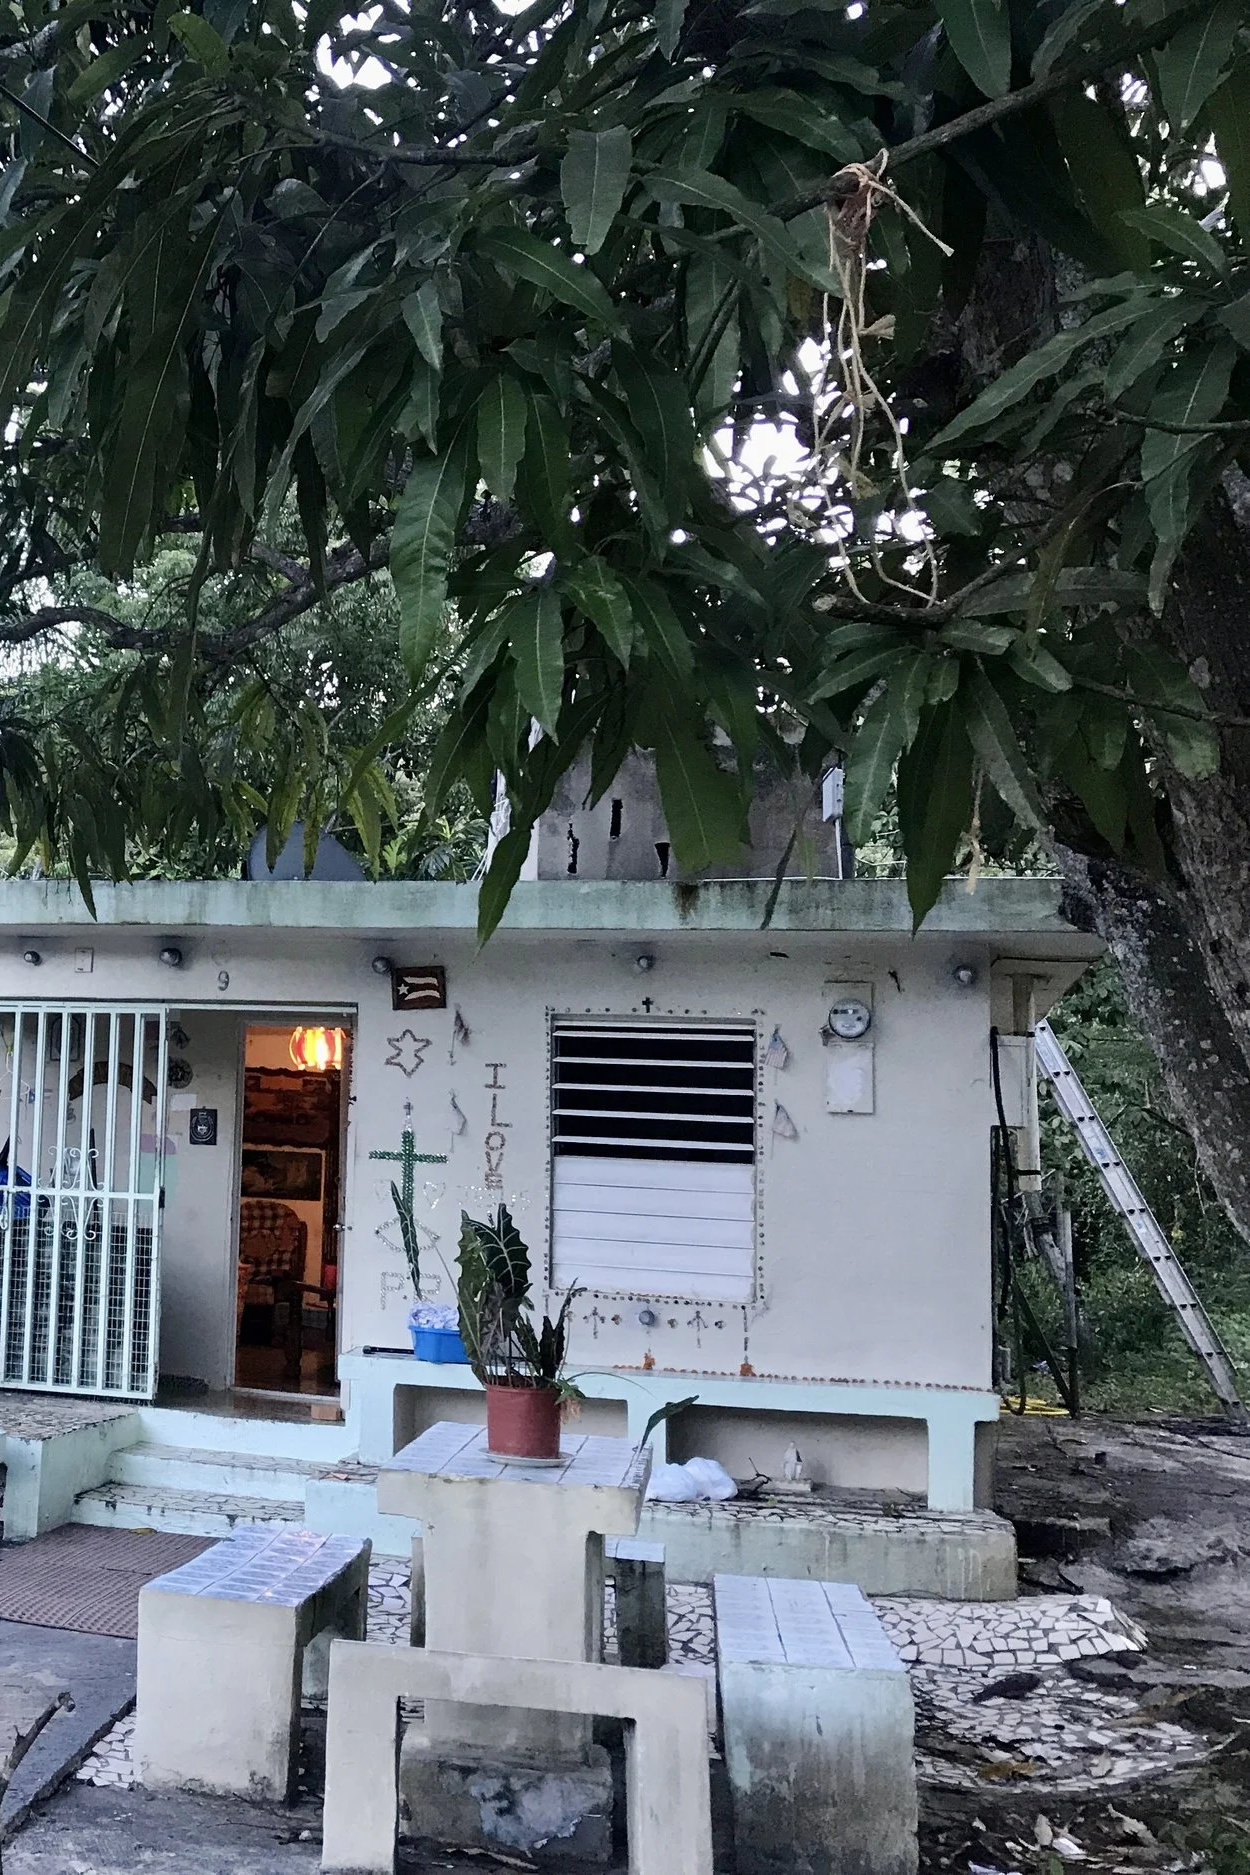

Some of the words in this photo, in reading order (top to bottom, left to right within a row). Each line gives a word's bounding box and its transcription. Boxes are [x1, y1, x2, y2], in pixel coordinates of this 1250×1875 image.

[217, 969, 230, 992] 9
[484, 1062, 507, 1090] I
[484, 1093, 514, 1191] LOVE
